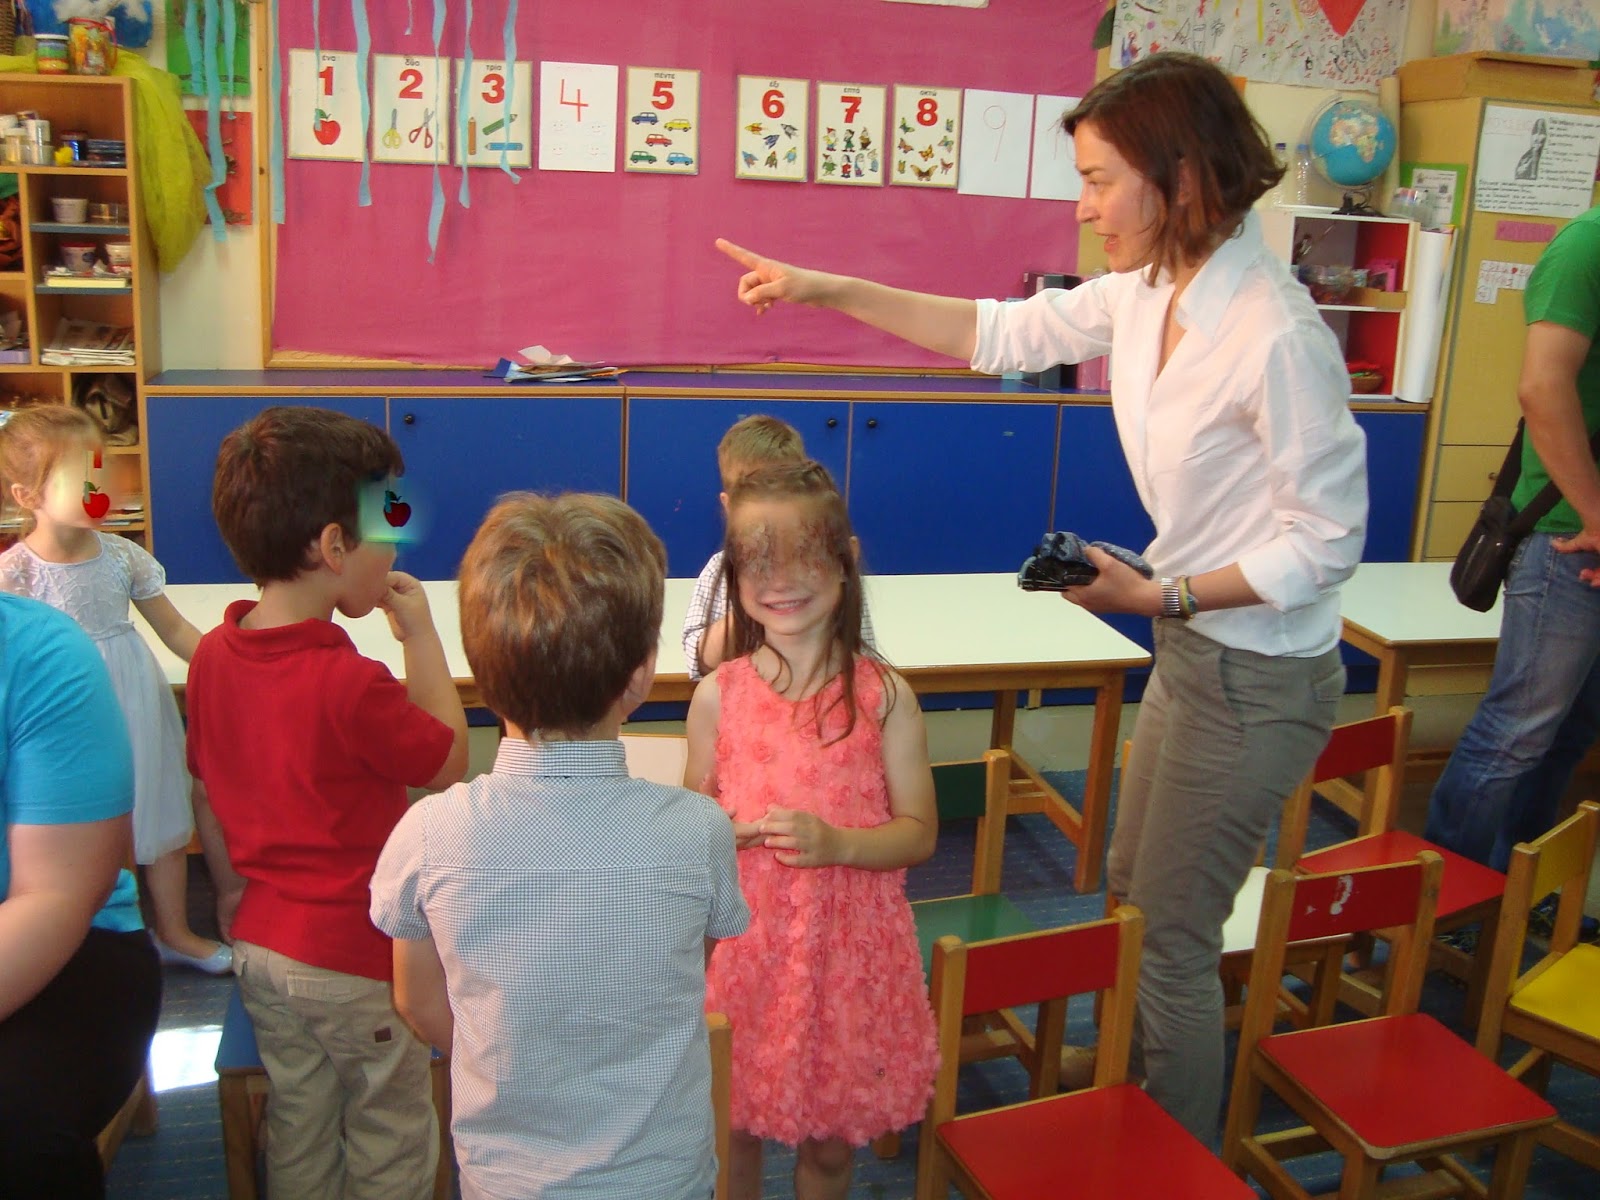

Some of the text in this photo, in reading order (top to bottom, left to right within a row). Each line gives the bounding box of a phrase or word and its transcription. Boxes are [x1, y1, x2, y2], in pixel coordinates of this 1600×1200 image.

[319, 67, 334, 96] 1
[400, 69, 423, 98] 2
[482, 73, 505, 103] 3
[651, 81, 675, 111] 5
[560, 79, 590, 122] 4
[762, 90, 784, 118] 6
[842, 96, 861, 123] 7
[917, 98, 937, 126] 8
[983, 104, 1007, 162] 9
